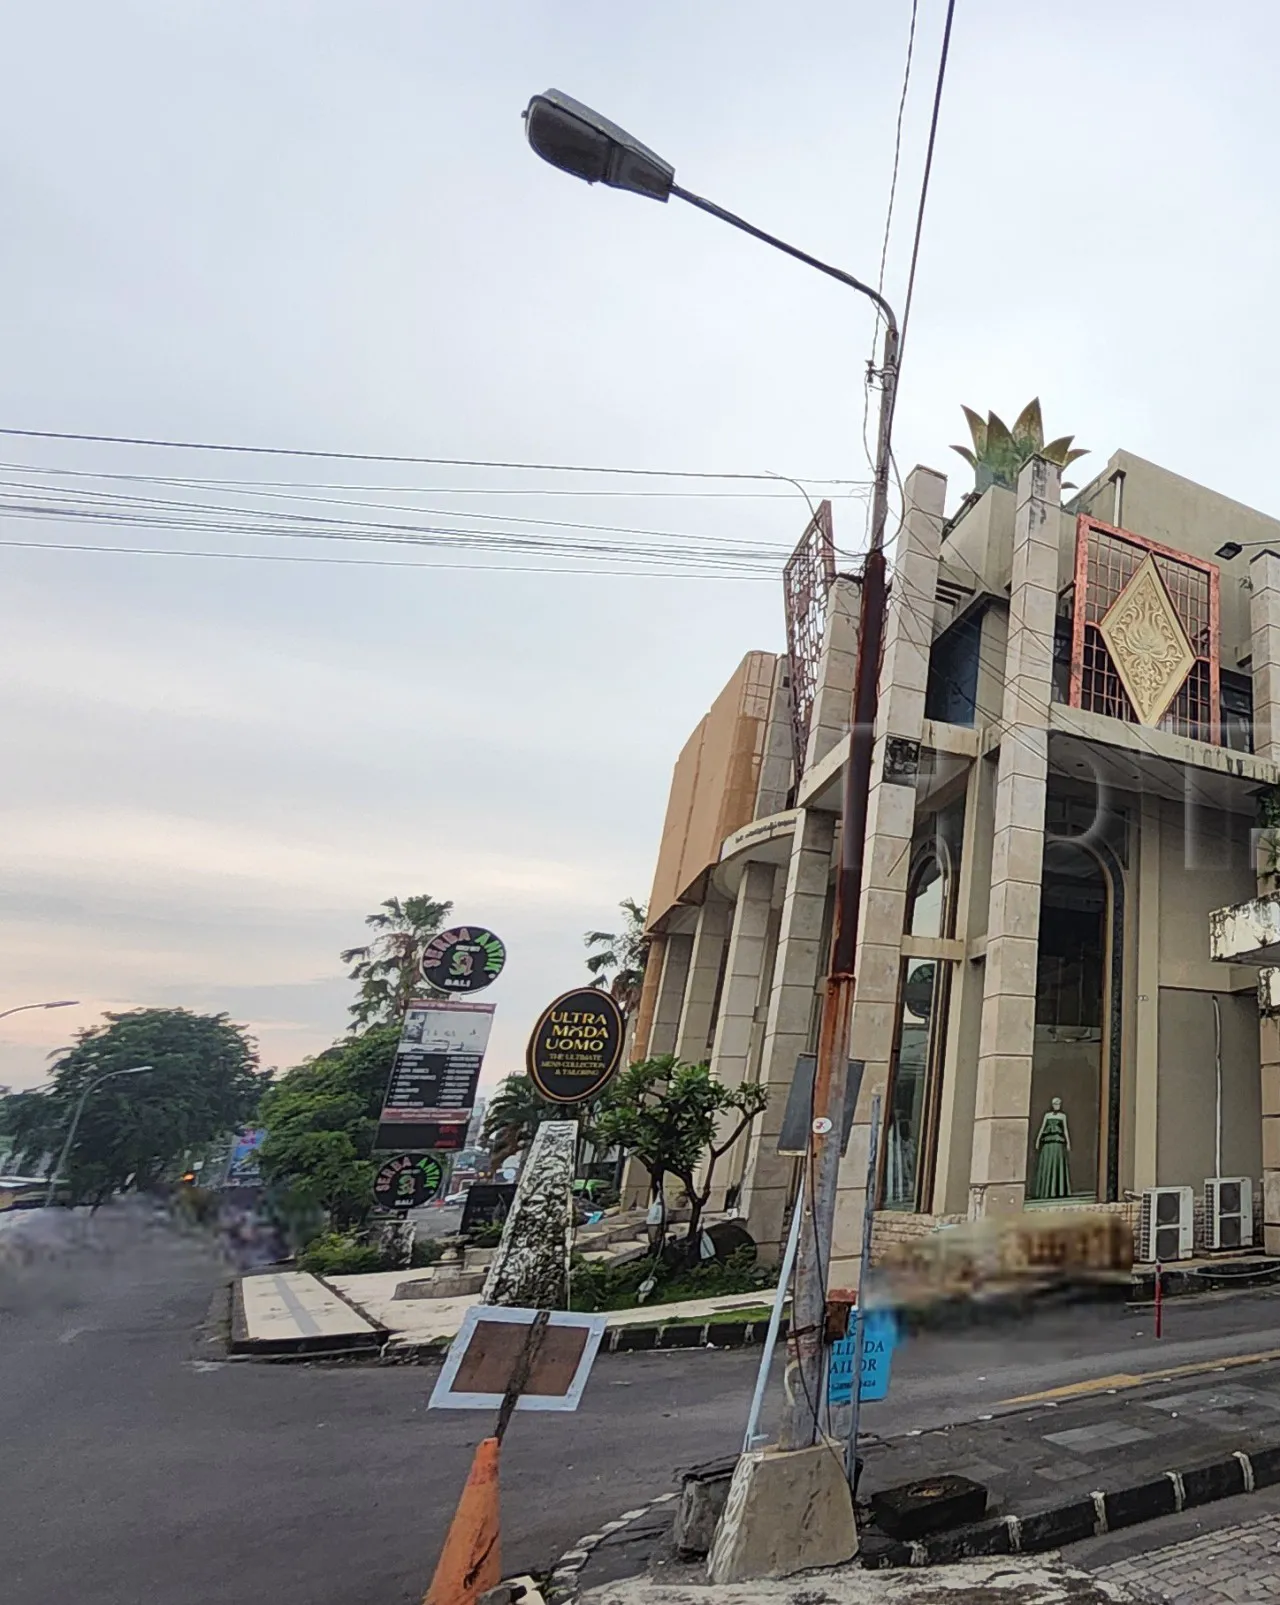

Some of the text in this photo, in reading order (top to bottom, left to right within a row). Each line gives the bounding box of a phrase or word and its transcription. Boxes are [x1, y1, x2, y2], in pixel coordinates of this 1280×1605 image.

[423, 927, 504, 974] SERBA ANTIK
[443, 978, 471, 988] BALI
[550, 1011, 608, 1025] ULTRA
[551, 1024, 609, 1039] MODA
[545, 1038, 604, 1052] UOMO
[375, 1156, 440, 1192] SERBA ANTIK
